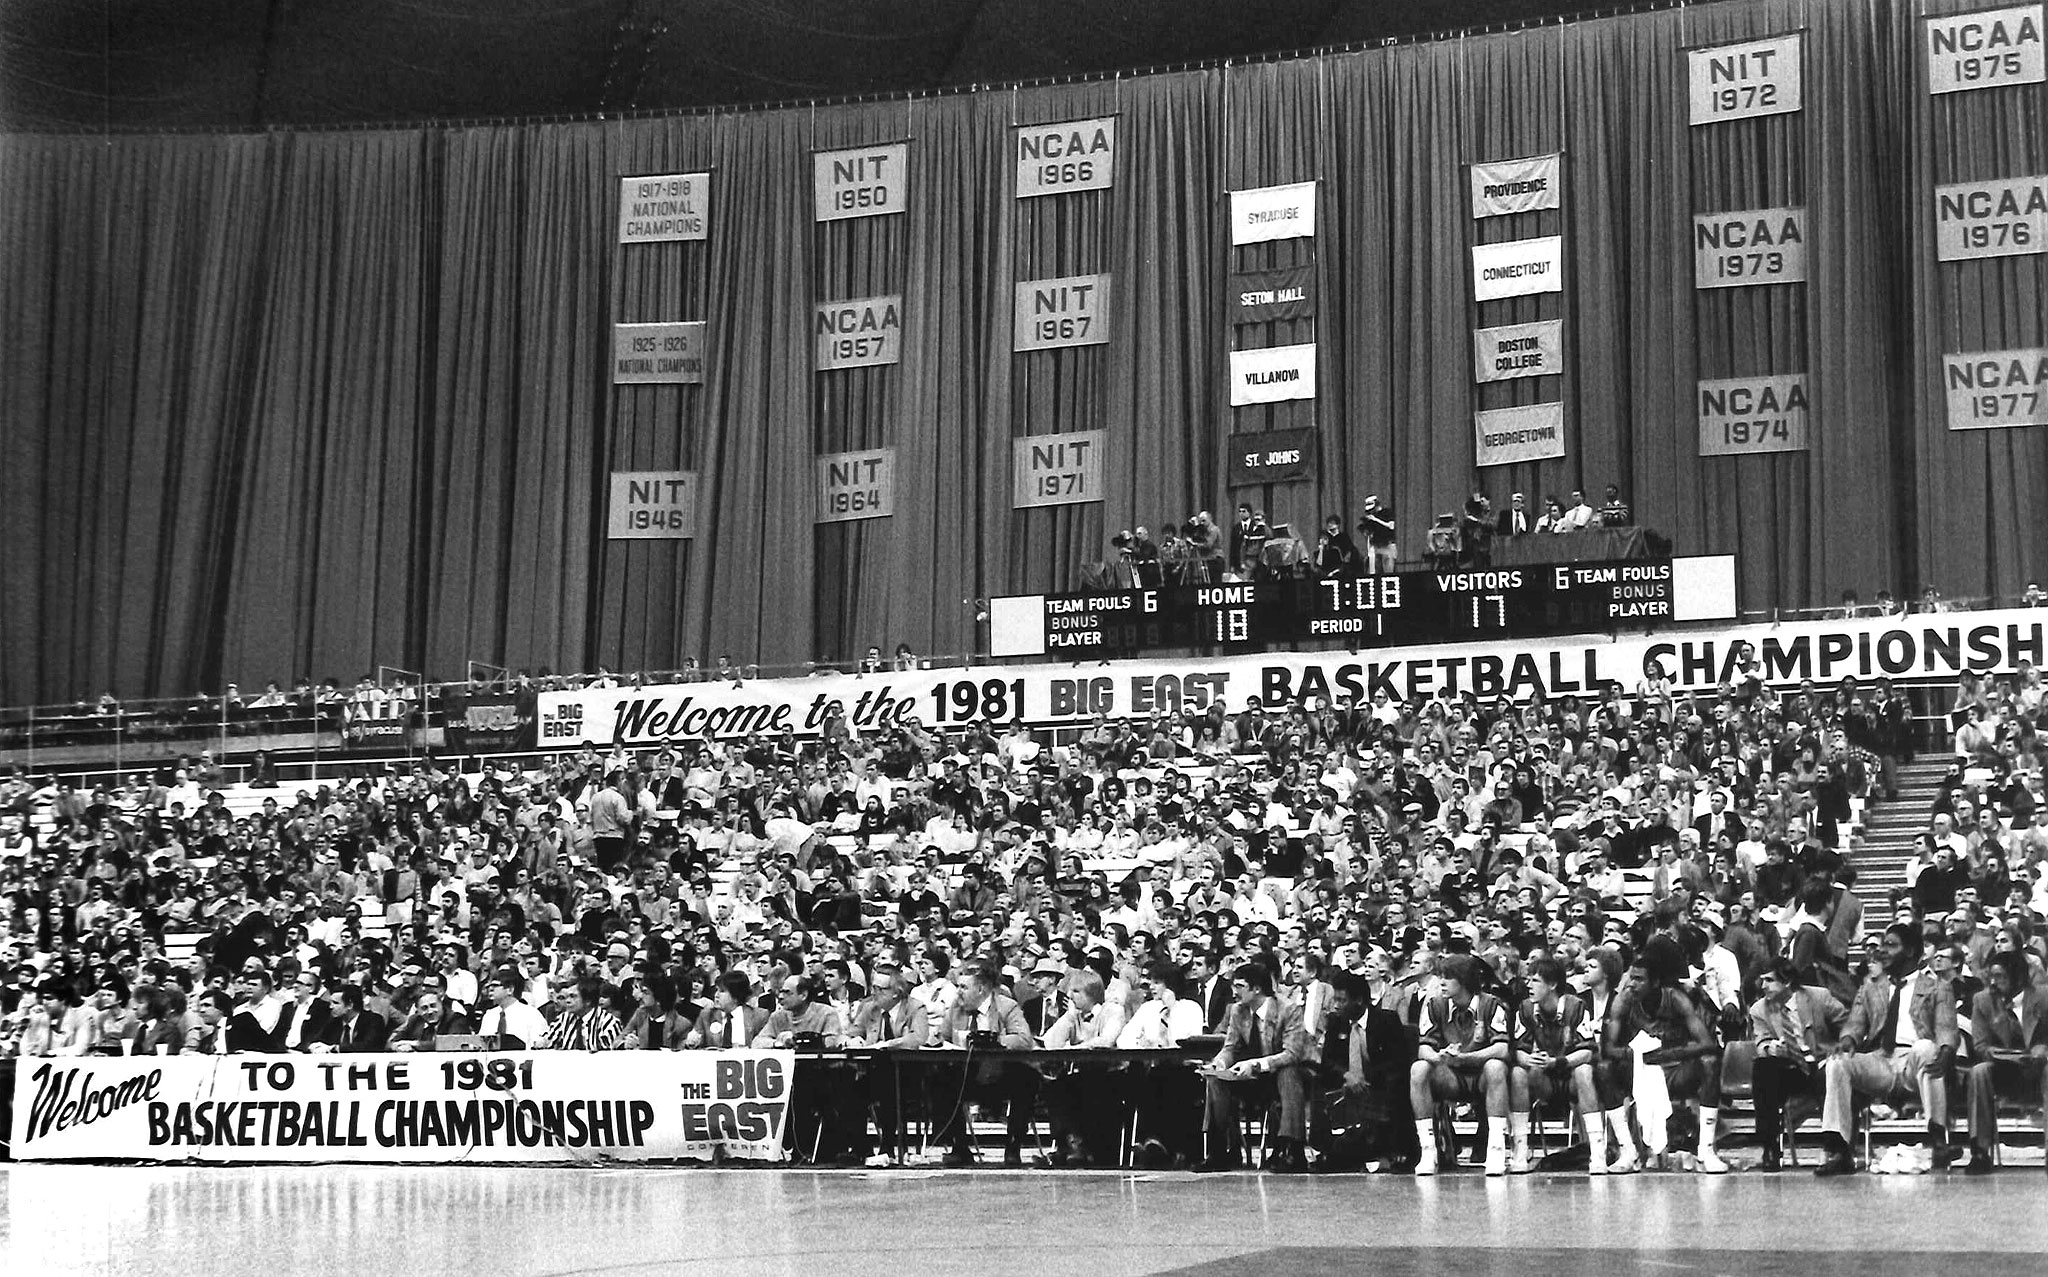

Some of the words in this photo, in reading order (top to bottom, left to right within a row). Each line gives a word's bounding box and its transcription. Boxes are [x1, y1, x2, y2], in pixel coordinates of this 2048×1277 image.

[1932, 17, 2039, 55] NCAA
[1710, 50, 1776, 84] NIT
[1955, 53, 2021, 82] 1975
[1712, 84, 1777, 112] 1972
[1021, 128, 1110, 159] NCAA
[833, 155, 888, 184] NIT
[1038, 161, 1094, 186] 1966
[638, 181, 691, 198] 1917-1918
[835, 186, 888, 211] 1950
[1484, 178, 1547, 198] PROVIDENCE
[633, 201, 695, 217] NATIONAL
[1248, 206, 1299, 225] SYRACUSE
[1941, 186, 2048, 221] NCAA
[627, 219, 702, 236] CHAMPIONS
[1697, 217, 1801, 250] NCAA
[1963, 222, 2030, 249] 1976
[1483, 261, 1551, 280] CONNECTICUT
[1718, 252, 1783, 278] 1973
[1036, 285, 1093, 314] NIT
[1240, 291, 1274, 306] SETON
[1278, 287, 1306, 301] HALL
[817, 304, 899, 336] NCAA
[1036, 316, 1091, 342] 1967
[832, 337, 885, 361] 1957
[1498, 337, 1538, 354] BOSTON
[618, 359, 653, 374] NATIONAL
[658, 358, 702, 374] CHAMPIONS
[1496, 353, 1542, 371] COLLEGE
[1948, 356, 2048, 390] NCAA
[1245, 369, 1299, 385] VILLANOVA
[1702, 386, 1808, 417] NCAA
[1972, 393, 2038, 418] 1977
[1485, 427, 1555, 447] GEORGETOWN
[1724, 420, 1789, 444] 1974
[1032, 441, 1090, 471] NIT
[1245, 454, 1260, 467] ST.
[1265, 450, 1300, 466] JOHN'S
[830, 459, 882, 487] NIT
[629, 480, 685, 505] NIT
[1038, 473, 1085, 498] 1971
[830, 490, 880, 514] 1964
[628, 510, 682, 531] 1946
[1436, 571, 1523, 592] VISITORS
[1555, 567, 1569, 590] 6
[1574, 568, 1617, 584] TEAM
[1622, 566, 1670, 582] FOULS
[1144, 591, 1157, 613] 6
[1198, 586, 1256, 606] HOME
[1319, 576, 1401, 611] 7:08
[1612, 585, 1665, 600] BONUS
[1046, 599, 1084, 614] TEAM
[1088, 596, 1131, 611] FOULS
[1473, 595, 1506, 628] 17
[1609, 601, 1669, 617] PLAYER
[1051, 615, 1099, 630] BONUS
[1216, 609, 1248, 641] 18
[1311, 618, 1363, 634] PERIOD
[1377, 613, 1382, 636] 1
[1049, 631, 1102, 648] PLAYER
[613, 697, 791, 744] Welcome
[853, 686, 916, 727] the
[931, 678, 1025, 722] 1981
[1050, 676, 1113, 716] BIG
[1131, 672, 1230, 714] EAST
[1261, 649, 1615, 708] BASKETBALL
[558, 704, 583, 719] BIG
[544, 721, 583, 737] EAST
[241, 1062, 295, 1091] TO
[318, 1061, 410, 1091] THE
[441, 1058, 533, 1091] 1981
[681, 1083, 710, 1099] THE
[716, 1058, 784, 1099] BIG
[26, 1063, 162, 1143] Welcome
[149, 1101, 367, 1146] BASKETBALL
[375, 1099, 654, 1147] CHAMPIONSHIP
[682, 1102, 785, 1141] EAST
